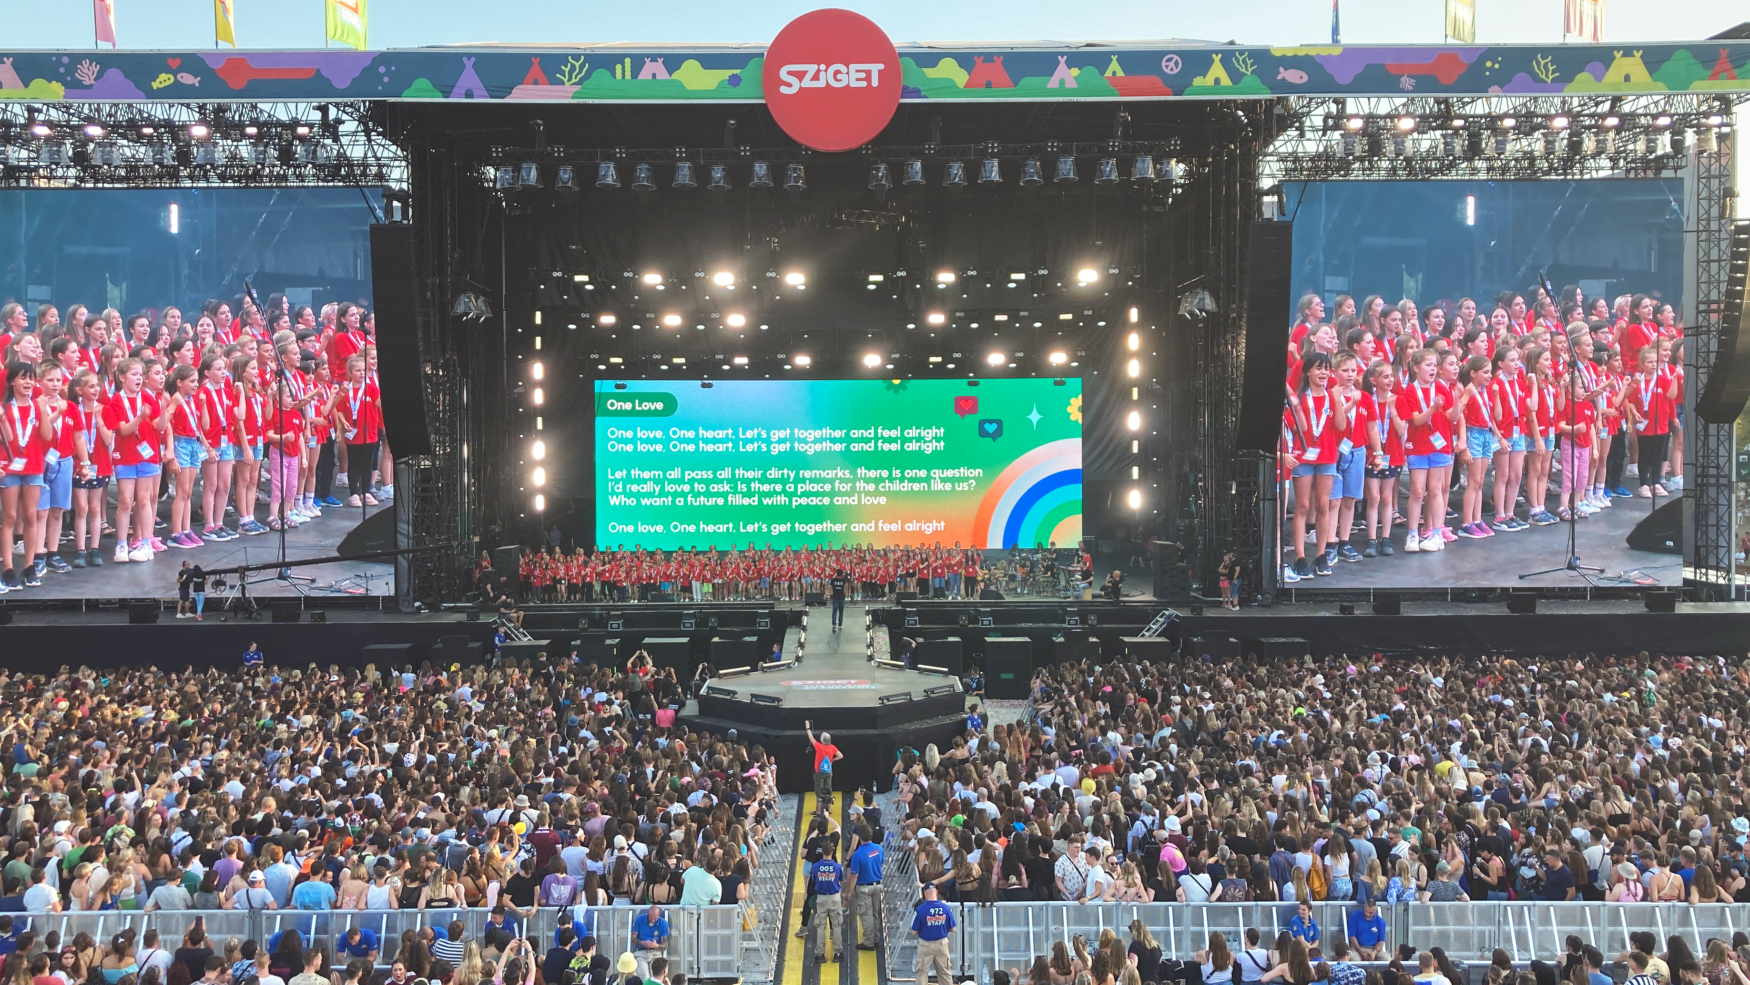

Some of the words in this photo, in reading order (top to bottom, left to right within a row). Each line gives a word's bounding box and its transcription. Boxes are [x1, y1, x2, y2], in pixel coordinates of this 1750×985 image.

[607, 399, 632, 410] One
[635, 399, 663, 410] Love
[608, 427, 633, 438] One
[637, 427, 665, 439] love,
[669, 427, 695, 438] One
[699, 427, 735, 439] heart,
[739, 427, 767, 438] Let's
[770, 428, 790, 441] get
[794, 427, 846, 441] together
[850, 427, 874, 438] and
[878, 427, 901, 438] feel
[904, 427, 944, 440] alright
[608, 441, 634, 452] One
[637, 441, 665, 452] love,
[669, 441, 695, 452] One
[699, 441, 735, 452] heart,
[739, 441, 767, 452] Let's
[770, 441, 790, 455] get
[794, 440, 846, 455] together
[850, 440, 874, 451] and
[878, 440, 901, 451] feel
[904, 440, 945, 454] alright
[608, 468, 627, 479] Let
[631, 468, 663, 479] them
[666, 468, 681, 479] all
[685, 471, 713, 481] pass
[717, 468, 731, 479] all
[735, 468, 763, 479] their
[766, 468, 796, 481] dirty
[799, 468, 853, 479] remarks,
[857, 467, 889, 478] there
[892, 468, 901, 477] is
[904, 470, 928, 478] one
[931, 467, 983, 480] question
[608, 482, 622, 492] I'd
[627, 481, 661, 495] really
[665, 481, 690, 492] love
[694, 482, 706, 492] to
[709, 481, 734, 492] ask:
[738, 481, 747, 492] Is
[751, 481, 782, 492] there
[786, 484, 794, 492] a
[797, 481, 831, 494] place
[835, 481, 852, 492] for
[856, 480, 875, 491] the
[878, 480, 928, 491] children
[931, 479, 952, 491] like
[955, 480, 976, 491] us?
[608, 495, 637, 506] Who
[641, 497, 672, 506] want
[676, 498, 684, 506] a
[688, 495, 724, 506] future
[728, 494, 758, 505] filled
[762, 495, 788, 505] with
[792, 497, 830, 508] peace
[834, 494, 858, 505] and
[861, 494, 887, 505] love
[608, 522, 634, 533] One
[638, 522, 666, 533] love,
[670, 522, 696, 532] One
[700, 522, 736, 533] heart,
[740, 522, 768, 532] Let's
[771, 522, 791, 535] get
[794, 521, 847, 535] together
[851, 521, 875, 532] and
[878, 520, 901, 531] feel
[905, 520, 945, 534] alright
